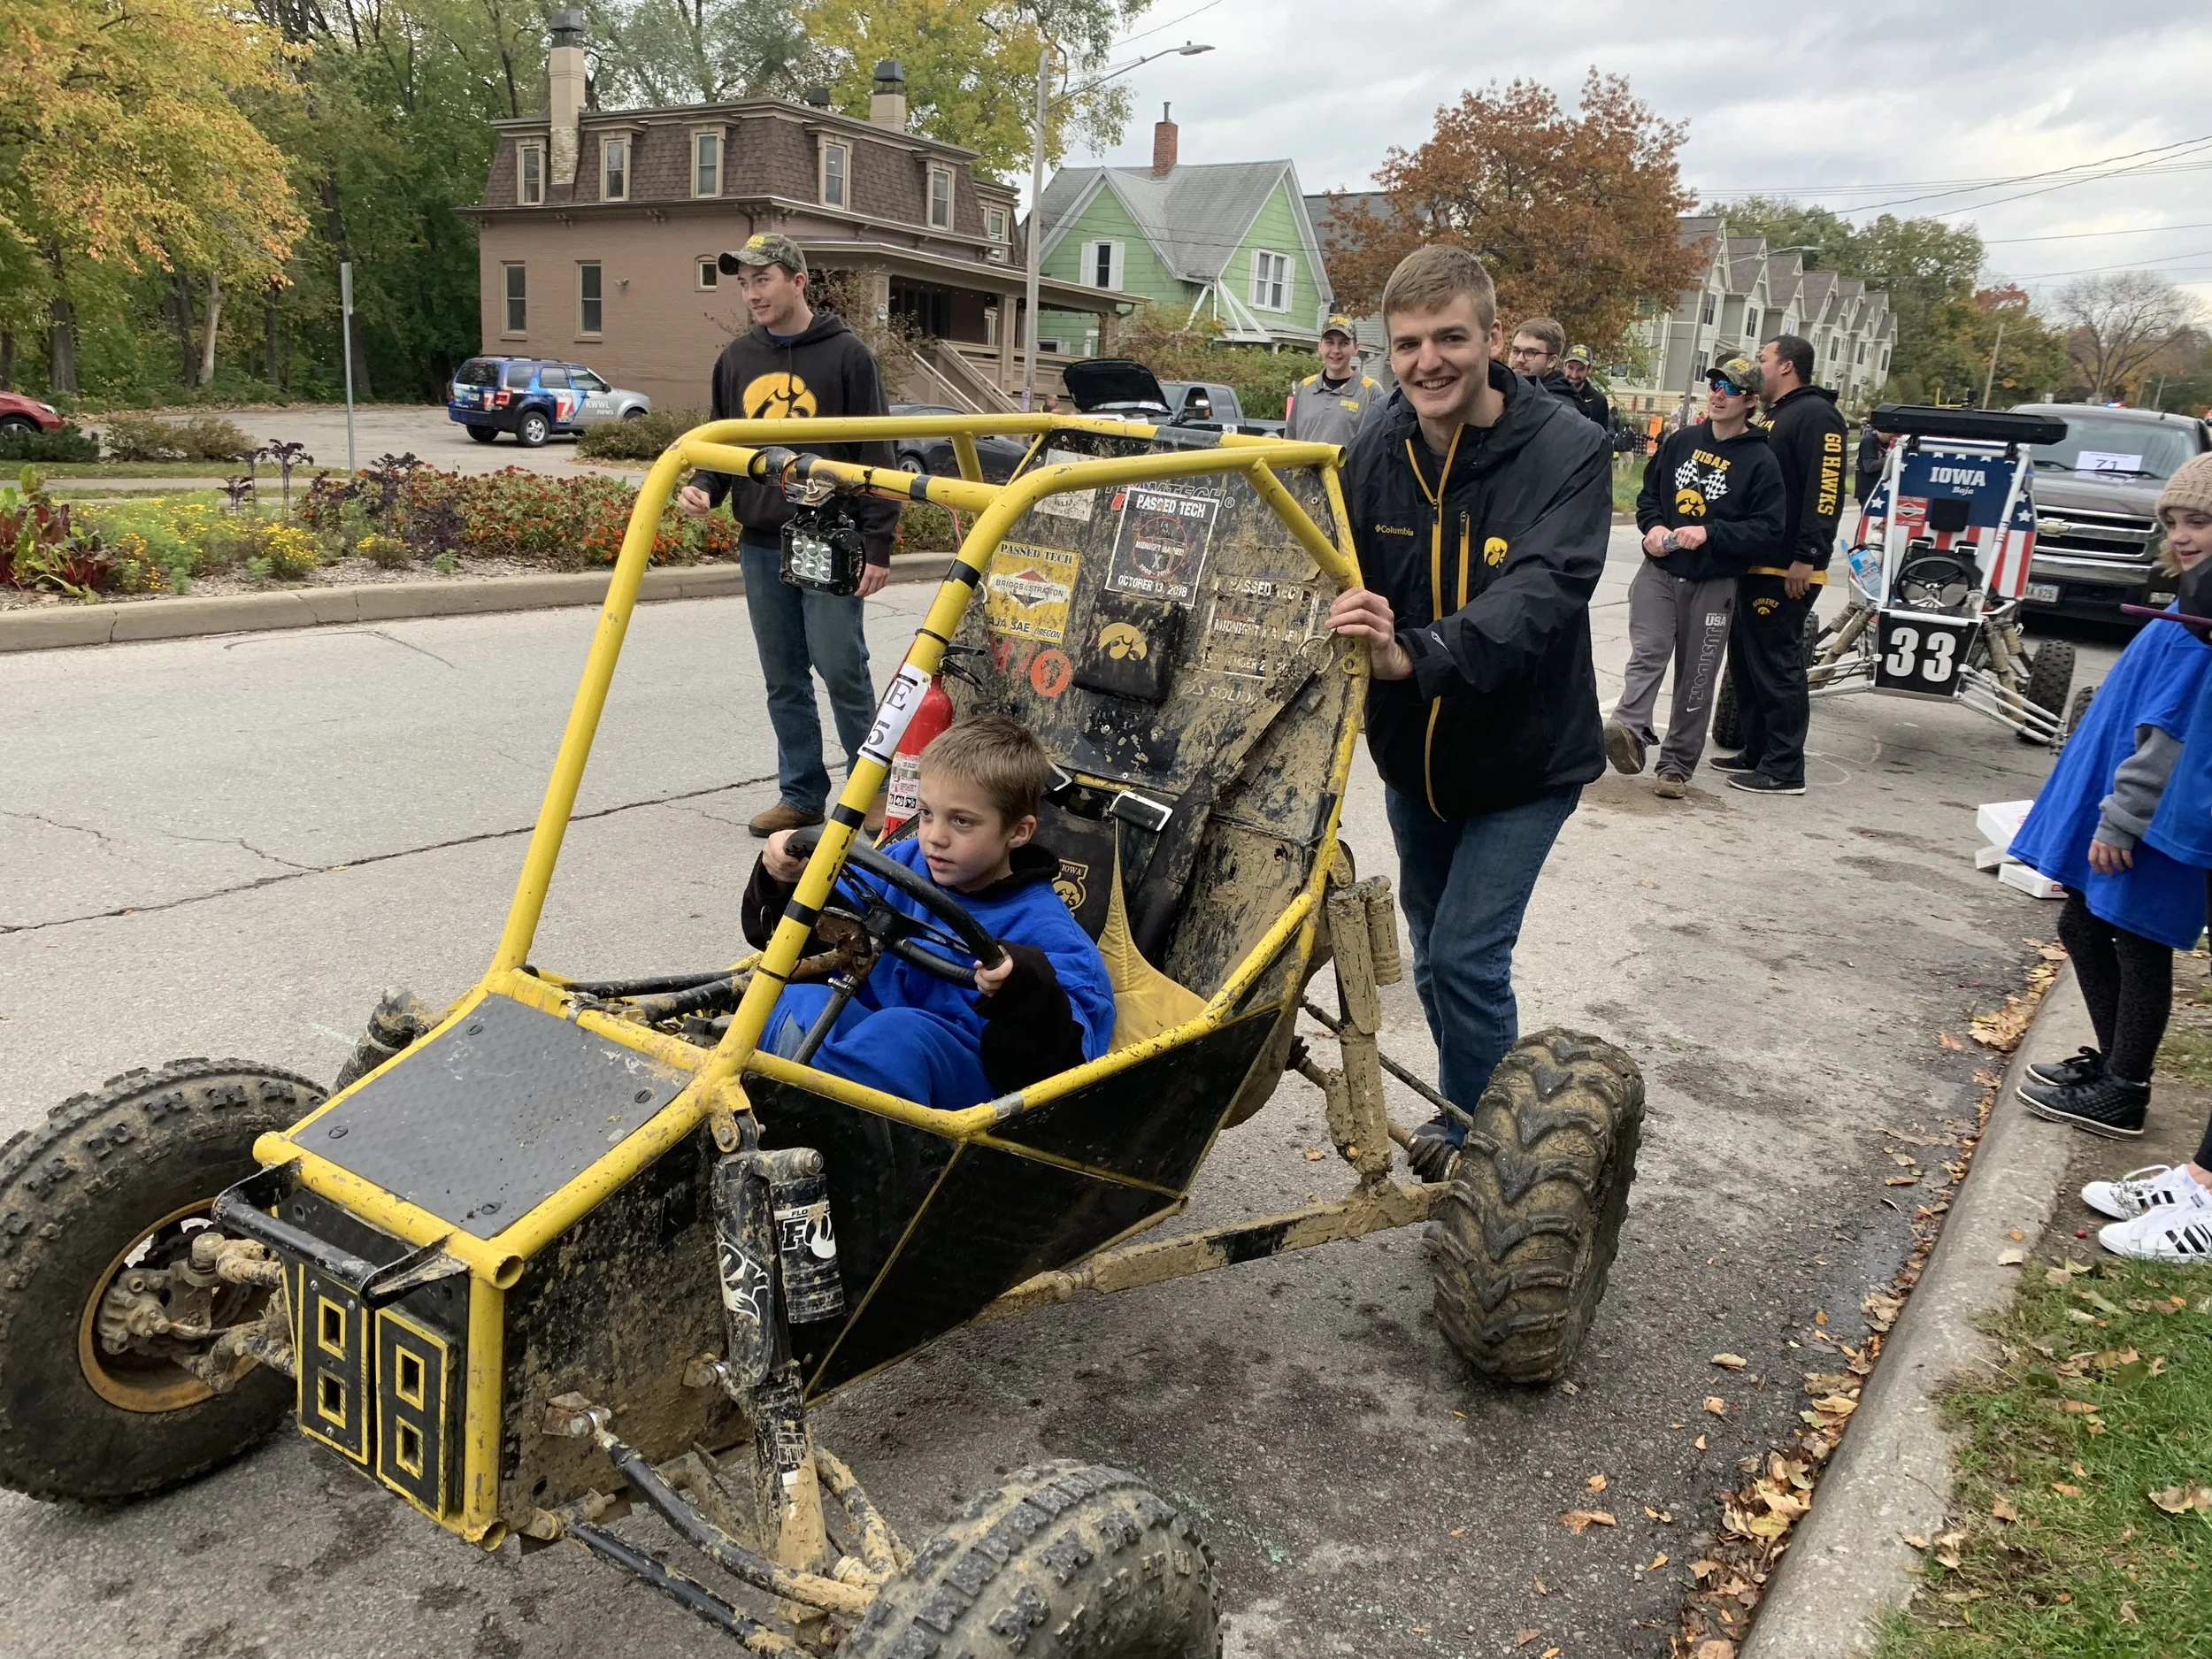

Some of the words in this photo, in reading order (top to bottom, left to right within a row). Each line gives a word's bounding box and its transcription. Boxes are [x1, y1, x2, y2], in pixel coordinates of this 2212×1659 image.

[586, 400, 611, 409] KWWL
[1824, 432, 1842, 454] GO
[1691, 449, 1732, 472] UISAE
[2095, 458, 2118, 471] 71
[1817, 456, 1841, 516] HAWKS
[1929, 465, 1986, 487] IOWA
[1952, 487, 1975, 495] Baja
[1136, 494, 1177, 514] PASSED
[1179, 502, 1207, 518] TECH
[1380, 525, 1414, 537] Columbia
[1000, 543, 1041, 559] PASSED
[1044, 551, 1073, 565] TECH
[1118, 574, 1154, 592] OCTOBER
[1167, 584, 1188, 598] 2018
[1010, 620, 1031, 633] SAE
[1033, 627, 1062, 639] OREGON
[1705, 616, 1727, 627] USA
[1886, 626, 1957, 683] 33
[886, 680, 914, 711] E
[867, 719, 891, 746] 5
[1061, 864, 1082, 876] IOWA
